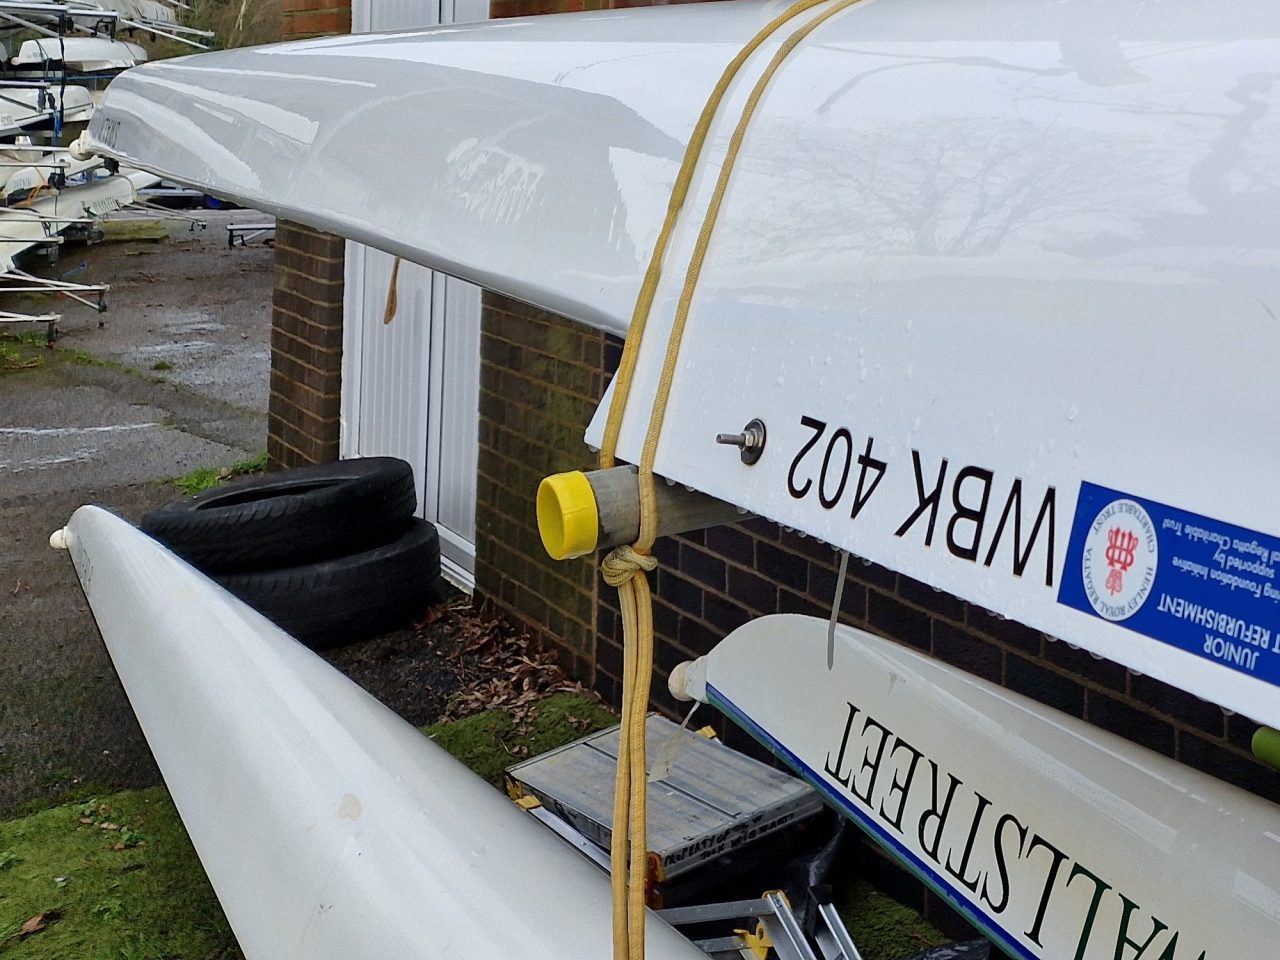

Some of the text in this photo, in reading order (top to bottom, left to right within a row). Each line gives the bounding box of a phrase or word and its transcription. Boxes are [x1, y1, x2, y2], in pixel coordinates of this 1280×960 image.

[787, 415, 1056, 587] WBK 402
[1093, 502, 1155, 554] CHARITABLE TRUST
[1163, 518, 1185, 536] Trust
[1184, 523, 1231, 550] Charitable
[1212, 546, 1275, 579] supported by
[1232, 540, 1269, 559] Regatta
[1085, 547, 1154, 617] HENLEY ROYAL REGATTA
[1172, 556, 1208, 579] Initiative
[1210, 570, 1262, 598] Foundation
[1157, 593, 1271, 640] REFURBISHMENT
[1203, 633, 1260, 671] JUNIOR
[824, 701, 1208, 960] ALLSTREET
